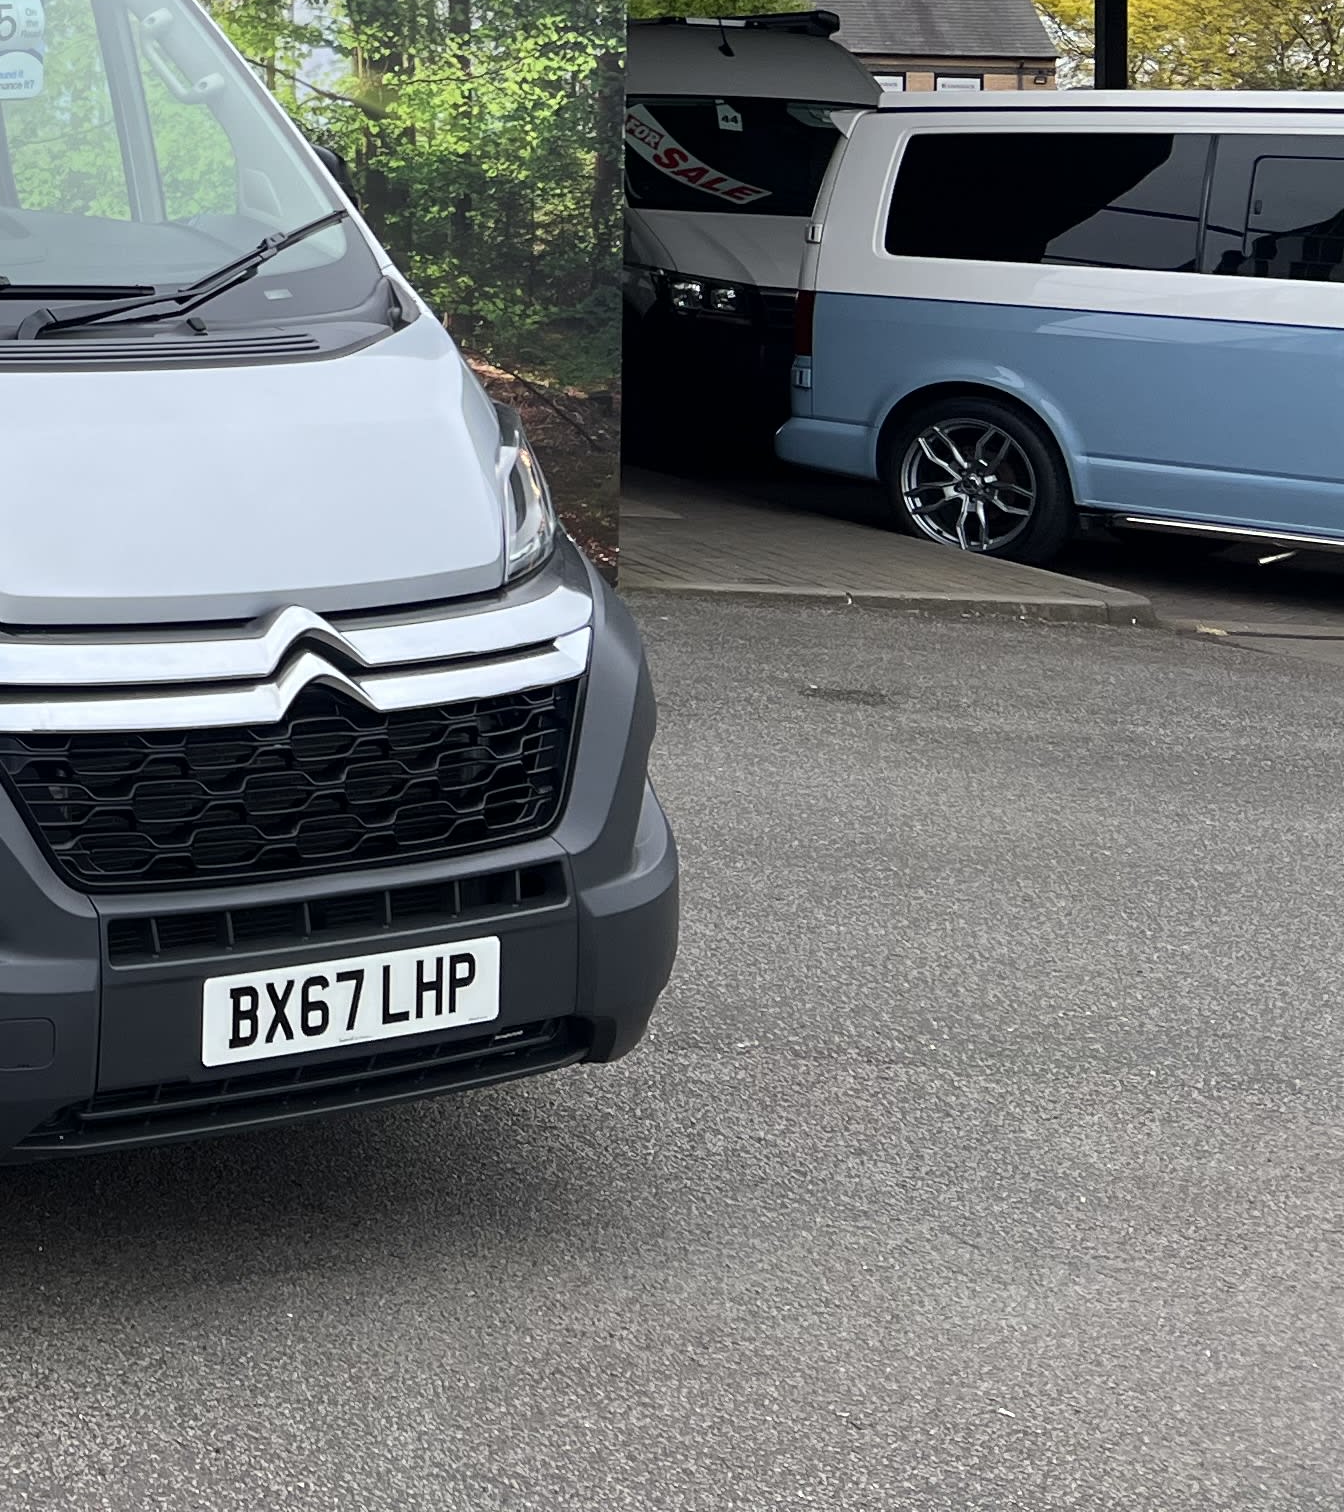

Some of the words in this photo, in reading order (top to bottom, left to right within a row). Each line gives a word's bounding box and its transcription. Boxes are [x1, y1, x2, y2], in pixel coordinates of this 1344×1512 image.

[626, 117, 660, 149] FOR
[652, 147, 764, 201] SALE
[228, 968, 365, 1050] BX67
[381, 951, 476, 1025] LHP
